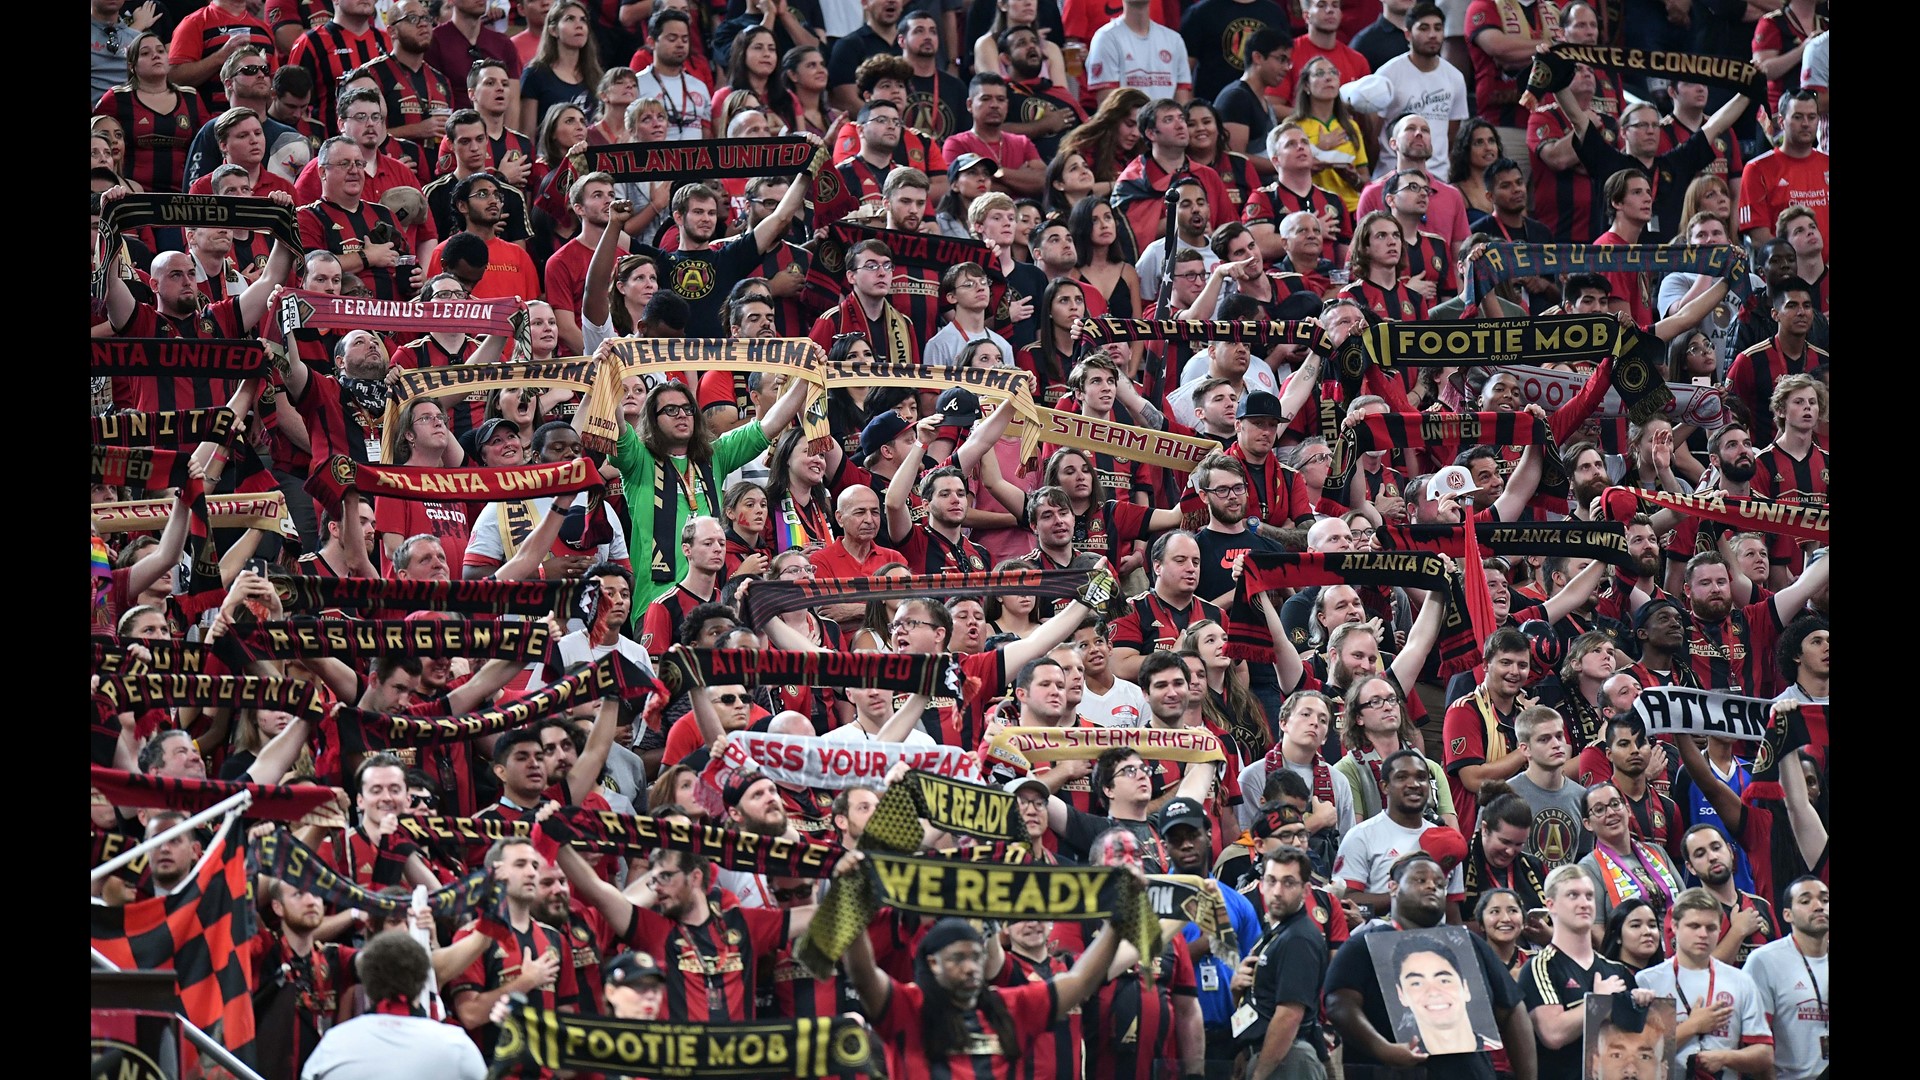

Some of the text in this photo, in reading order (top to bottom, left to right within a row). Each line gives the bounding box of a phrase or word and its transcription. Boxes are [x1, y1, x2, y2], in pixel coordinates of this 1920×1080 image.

[1554, 47, 1757, 86] UNITE & CONQUER
[596, 144, 812, 174] ATLANTA UNITED
[171, 196, 218, 205] ATLANTA
[1789, 190, 1825, 198] Standard
[160, 204, 230, 222] UNITED
[486, 263, 519, 273] olumbia
[936, 241, 1000, 269] UNITE
[1485, 244, 1746, 280] RESURGENCE
[331, 298, 493, 320] TERMINUS LEGION
[1082, 318, 1334, 351] RESURGENCE
[1399, 322, 1609, 355] FOOTIE MOB
[1478, 320, 1531, 331] HOME AT LAST
[92, 344, 263, 372] NTA UNITED
[610, 337, 818, 371] WELCOME HOME
[1490, 354, 1518, 362] 09.10.17
[827, 361, 935, 380] ELCOME
[101, 410, 236, 440] UNITE
[1320, 397, 1339, 456] NITE
[1420, 421, 1482, 440] UNITED
[1429, 413, 1473, 422] ATLANTA
[1051, 414, 1152, 451] STEAM
[1154, 435, 1210, 462] AHE
[91, 459, 154, 481] NITED
[377, 461, 588, 493] ATLANTA UNITED
[93, 504, 173, 521] STEA
[1738, 500, 1829, 532] UNITED
[1489, 528, 1629, 553] ATLANTA IS UNITE
[1340, 554, 1443, 577] ATLANTA IS
[269, 626, 548, 656] RESURGENCE
[711, 650, 914, 680] ATLANTA UNITED
[101, 673, 325, 714] RESURGENCE
[1646, 689, 1767, 738] ATLAN
[1065, 730, 1141, 749] STEAM
[1147, 731, 1219, 752] AHEAD
[727, 738, 986, 781] BESS YOUR HEAR
[920, 777, 1015, 835] WE READY
[1536, 808, 1573, 830] ATLANTA
[875, 859, 946, 909] WE
[957, 868, 1110, 915] READY
[566, 1025, 789, 1067] FOOTIE MOB
